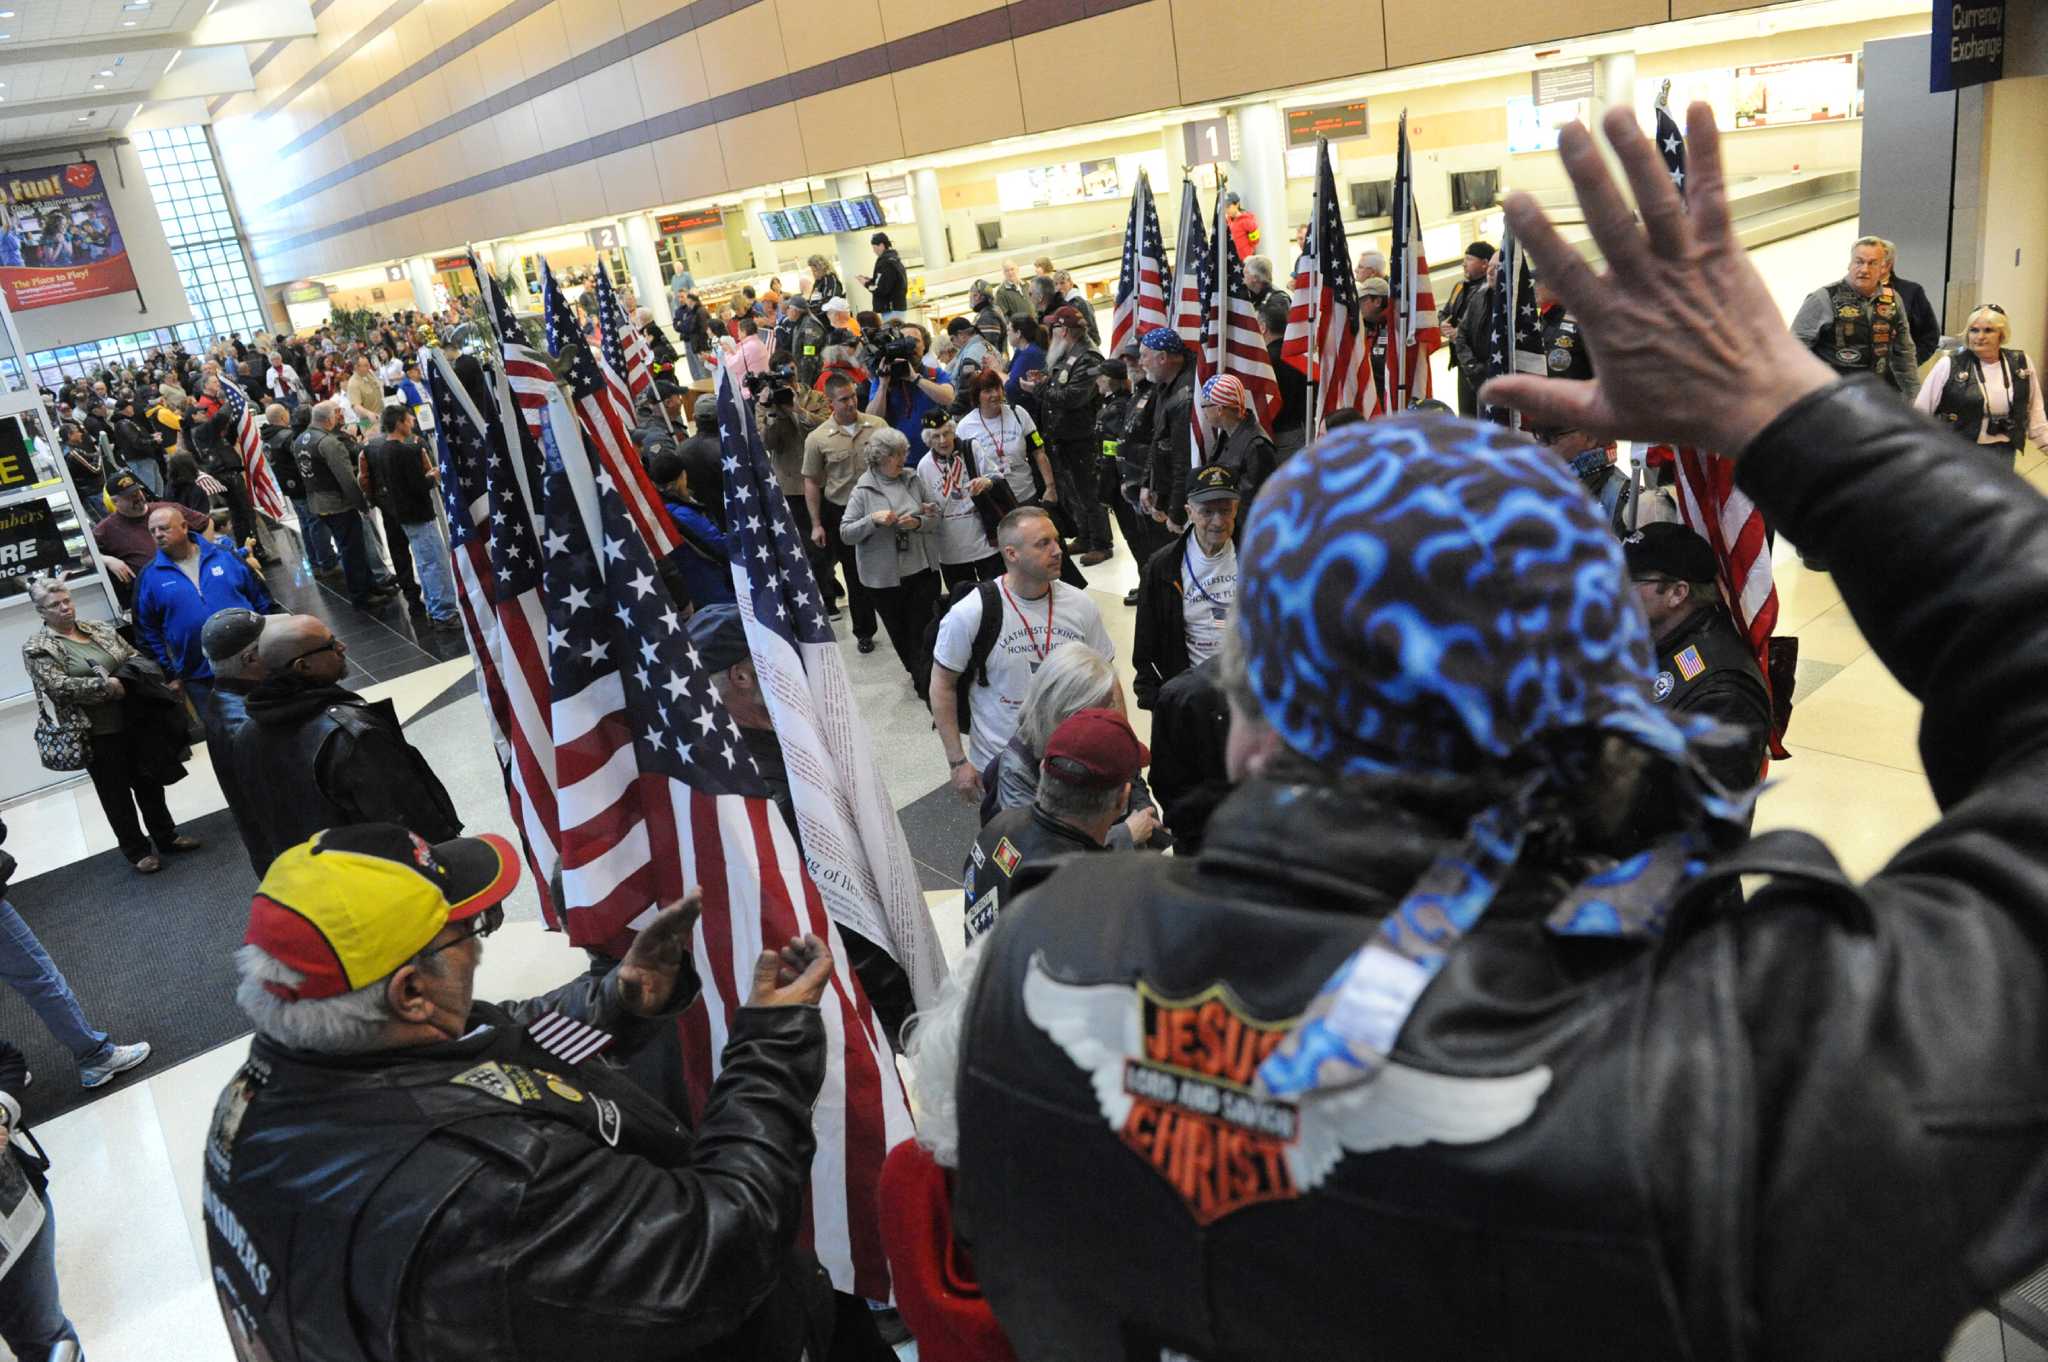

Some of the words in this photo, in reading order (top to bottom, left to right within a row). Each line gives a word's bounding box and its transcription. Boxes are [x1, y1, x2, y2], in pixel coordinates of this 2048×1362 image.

[1951, 33, 2002, 63] Exchange
[1205, 126, 1219, 157] 1
[9, 175, 65, 201] Fun!
[601, 229, 614, 247] 2
[12, 280, 30, 289] The
[1000, 625, 1085, 649] LEATHSTOCKING
[823, 869, 841, 883] of
[1129, 1102, 1286, 1210] CHRIST
